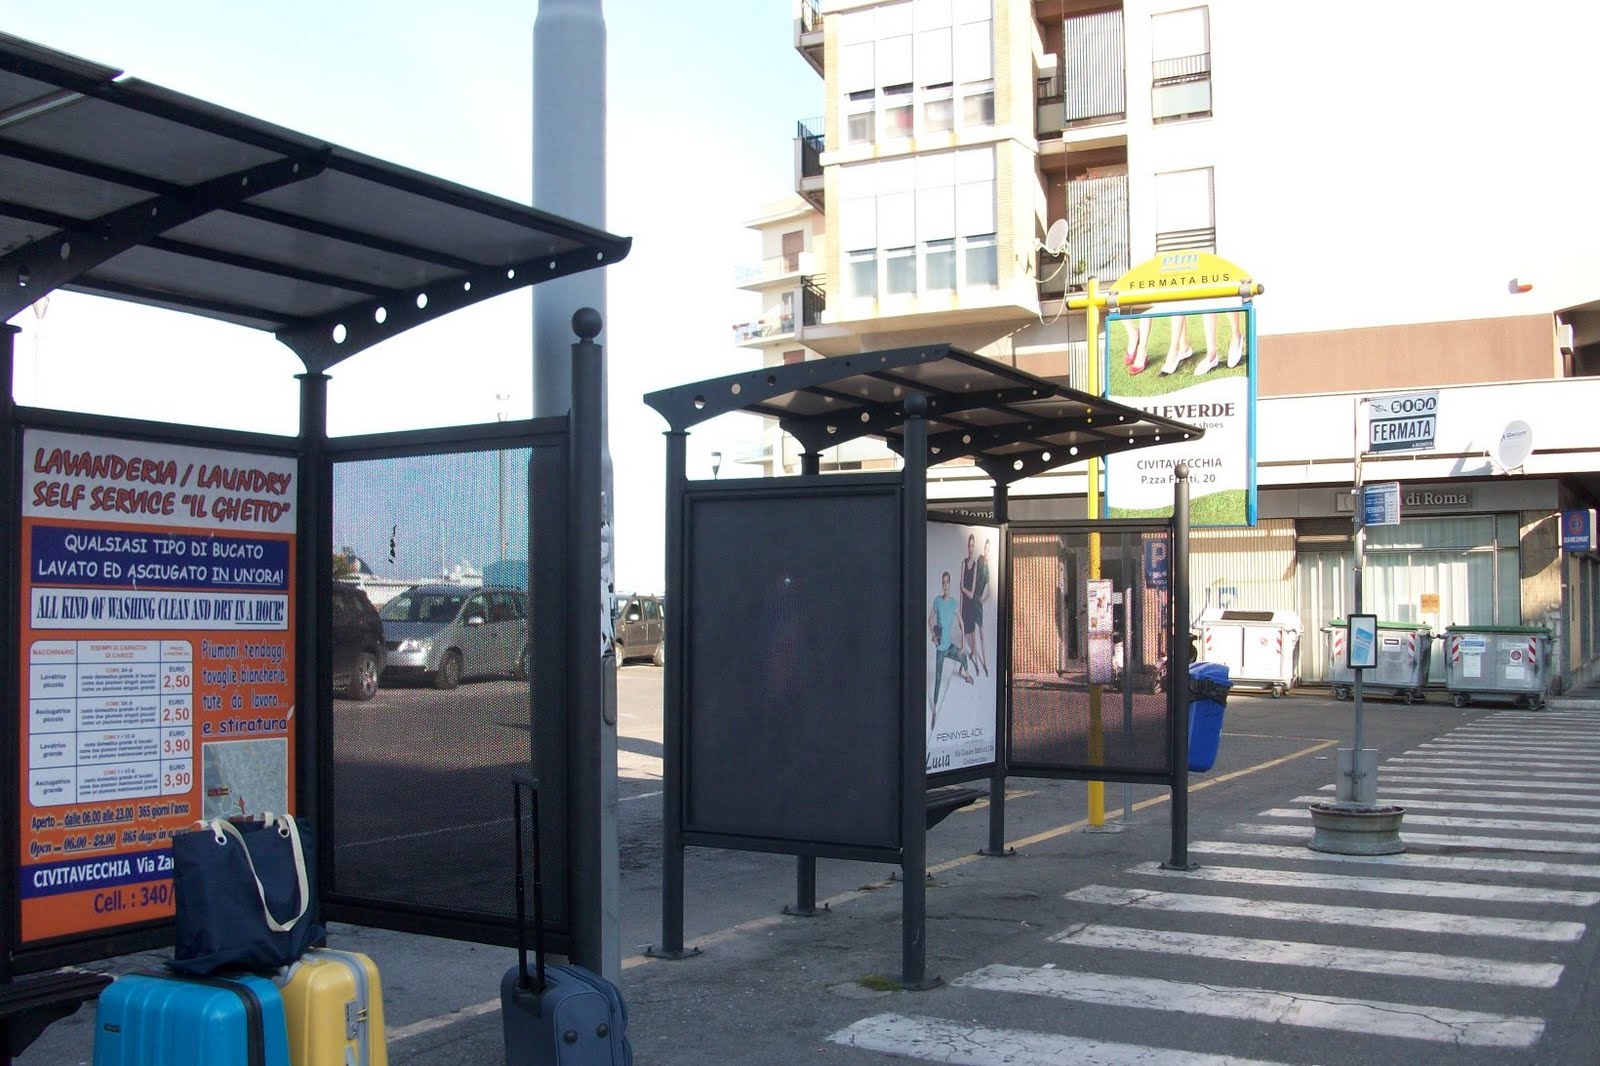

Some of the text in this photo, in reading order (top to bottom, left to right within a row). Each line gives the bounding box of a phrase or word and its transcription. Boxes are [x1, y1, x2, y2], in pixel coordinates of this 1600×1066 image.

[1129, 277, 1196, 289] FERMATA
[1201, 273, 1230, 283] BUS
[1374, 420, 1431, 441] FERMATA
[34, 447, 292, 496] LAVANDERIA / LAUNDRY
[1203, 474, 1216, 483] 20
[32, 480, 87, 511] SELF
[89, 485, 176, 516] SERVICE
[1406, 493, 1420, 505] di
[1424, 492, 1467, 505] Roma
[65, 534, 264, 559] QUALSIASI TIPO DI BUCATO
[39, 559, 284, 584] LAVATO ED ASCIUGATO IN UN'ORA!
[37, 595, 285, 622] ALL KIND OF WASHING CLEAN AND DRY IN A HOUR!
[163, 674, 190, 690] 2,50
[203, 692, 221, 709] tute
[163, 707, 190, 723] 2,50
[203, 717, 287, 733] e stiratura
[937, 728, 983, 742] PENNYBLACK
[163, 738, 190, 755] 3,90
[926, 751, 950, 770] Lucia
[163, 772, 190, 788] 3,90
[32, 815, 55, 831] Aperto
[64, 811, 81, 826] dalle
[82, 809, 101, 824] 06.00
[102, 808, 114, 822] alle
[116, 806, 134, 820] 23.00
[138, 805, 150, 818] 365
[151, 803, 170, 819] giorni
[30, 841, 52, 857] Open
[63, 836, 87, 851] 06.00
[93, 833, 116, 847] 23.00
[122, 830, 137, 844] 365
[138, 829, 157, 843] days
[158, 827, 167, 839] in
[33, 859, 131, 888] CIVITAVECCHIA
[137, 856, 155, 873] Via
[93, 890, 126, 913] Cell.
